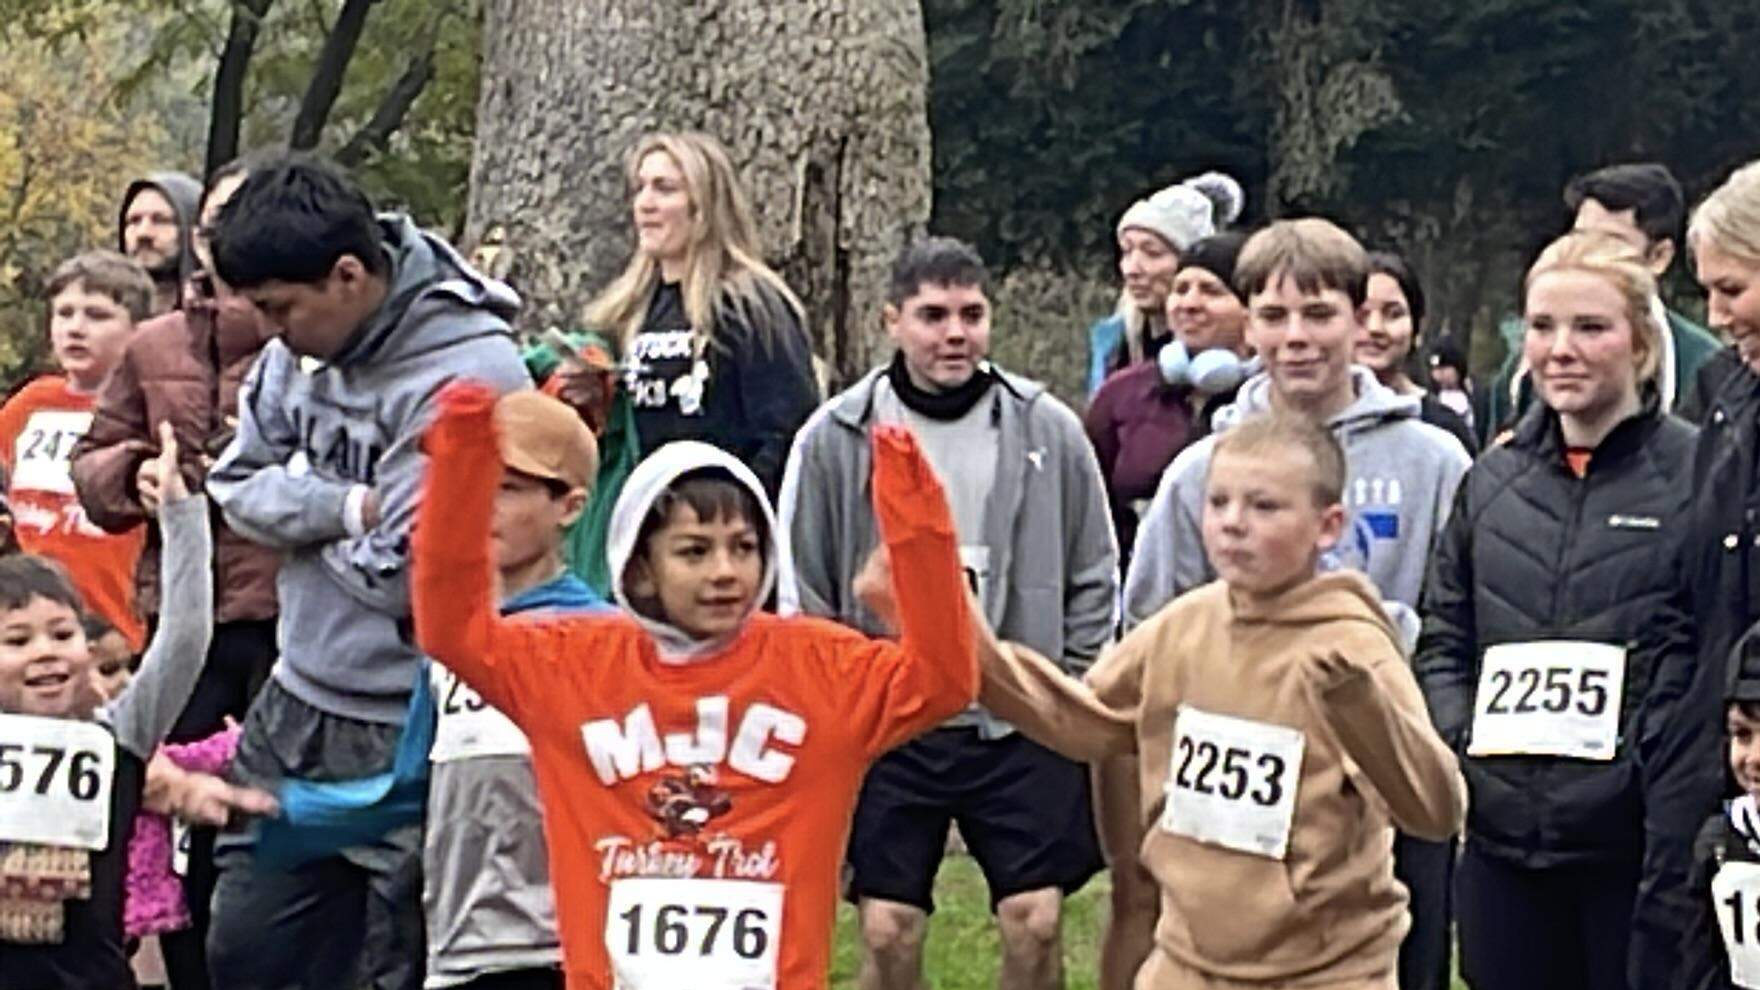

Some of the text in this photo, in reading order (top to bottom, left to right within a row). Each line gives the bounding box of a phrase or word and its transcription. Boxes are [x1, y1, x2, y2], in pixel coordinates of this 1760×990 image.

[1486, 668, 1609, 716] 2255
[580, 695, 807, 786] MJC
[1176, 735, 1286, 806] 2253
[595, 834, 703, 882] Turkey
[619, 903, 769, 960] 1676
